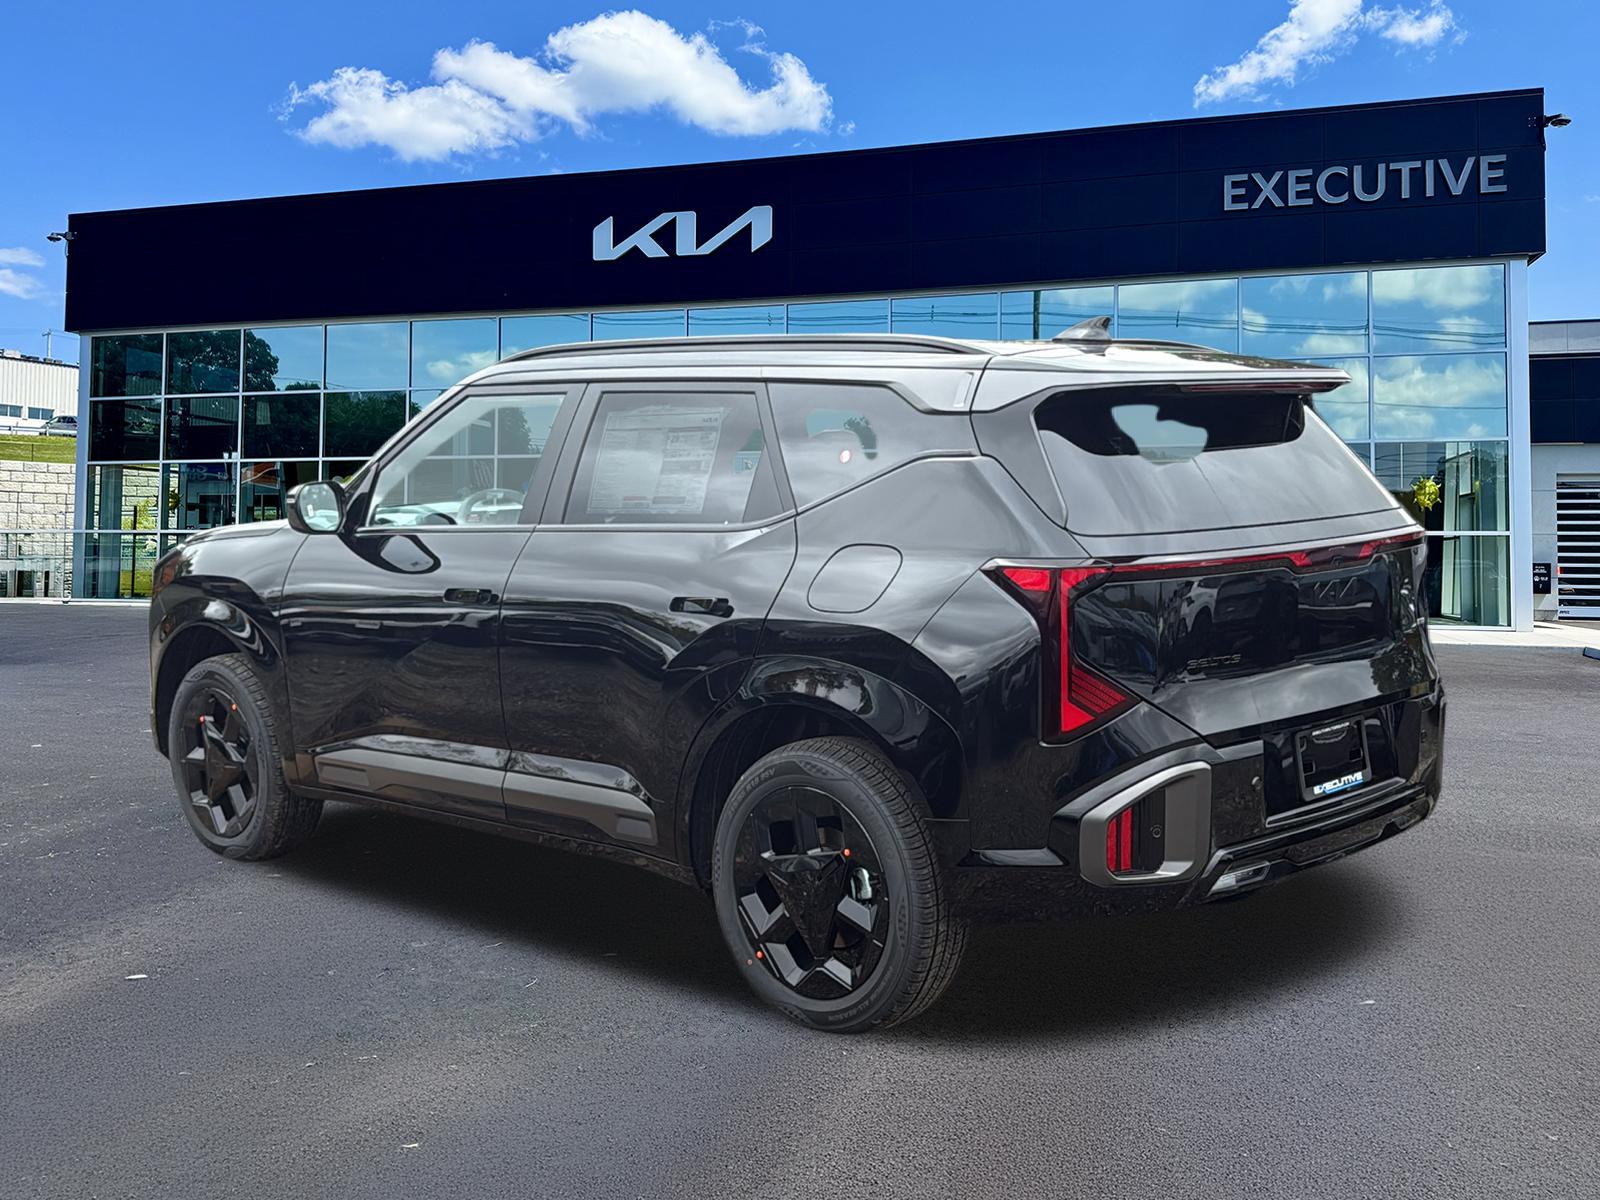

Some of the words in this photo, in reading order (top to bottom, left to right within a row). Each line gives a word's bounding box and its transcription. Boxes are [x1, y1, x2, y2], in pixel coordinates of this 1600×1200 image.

[1223, 154, 1508, 211] EXECUTIVE
[593, 205, 773, 261] KIA
[1313, 771, 1363, 795] EXECUTIVE
